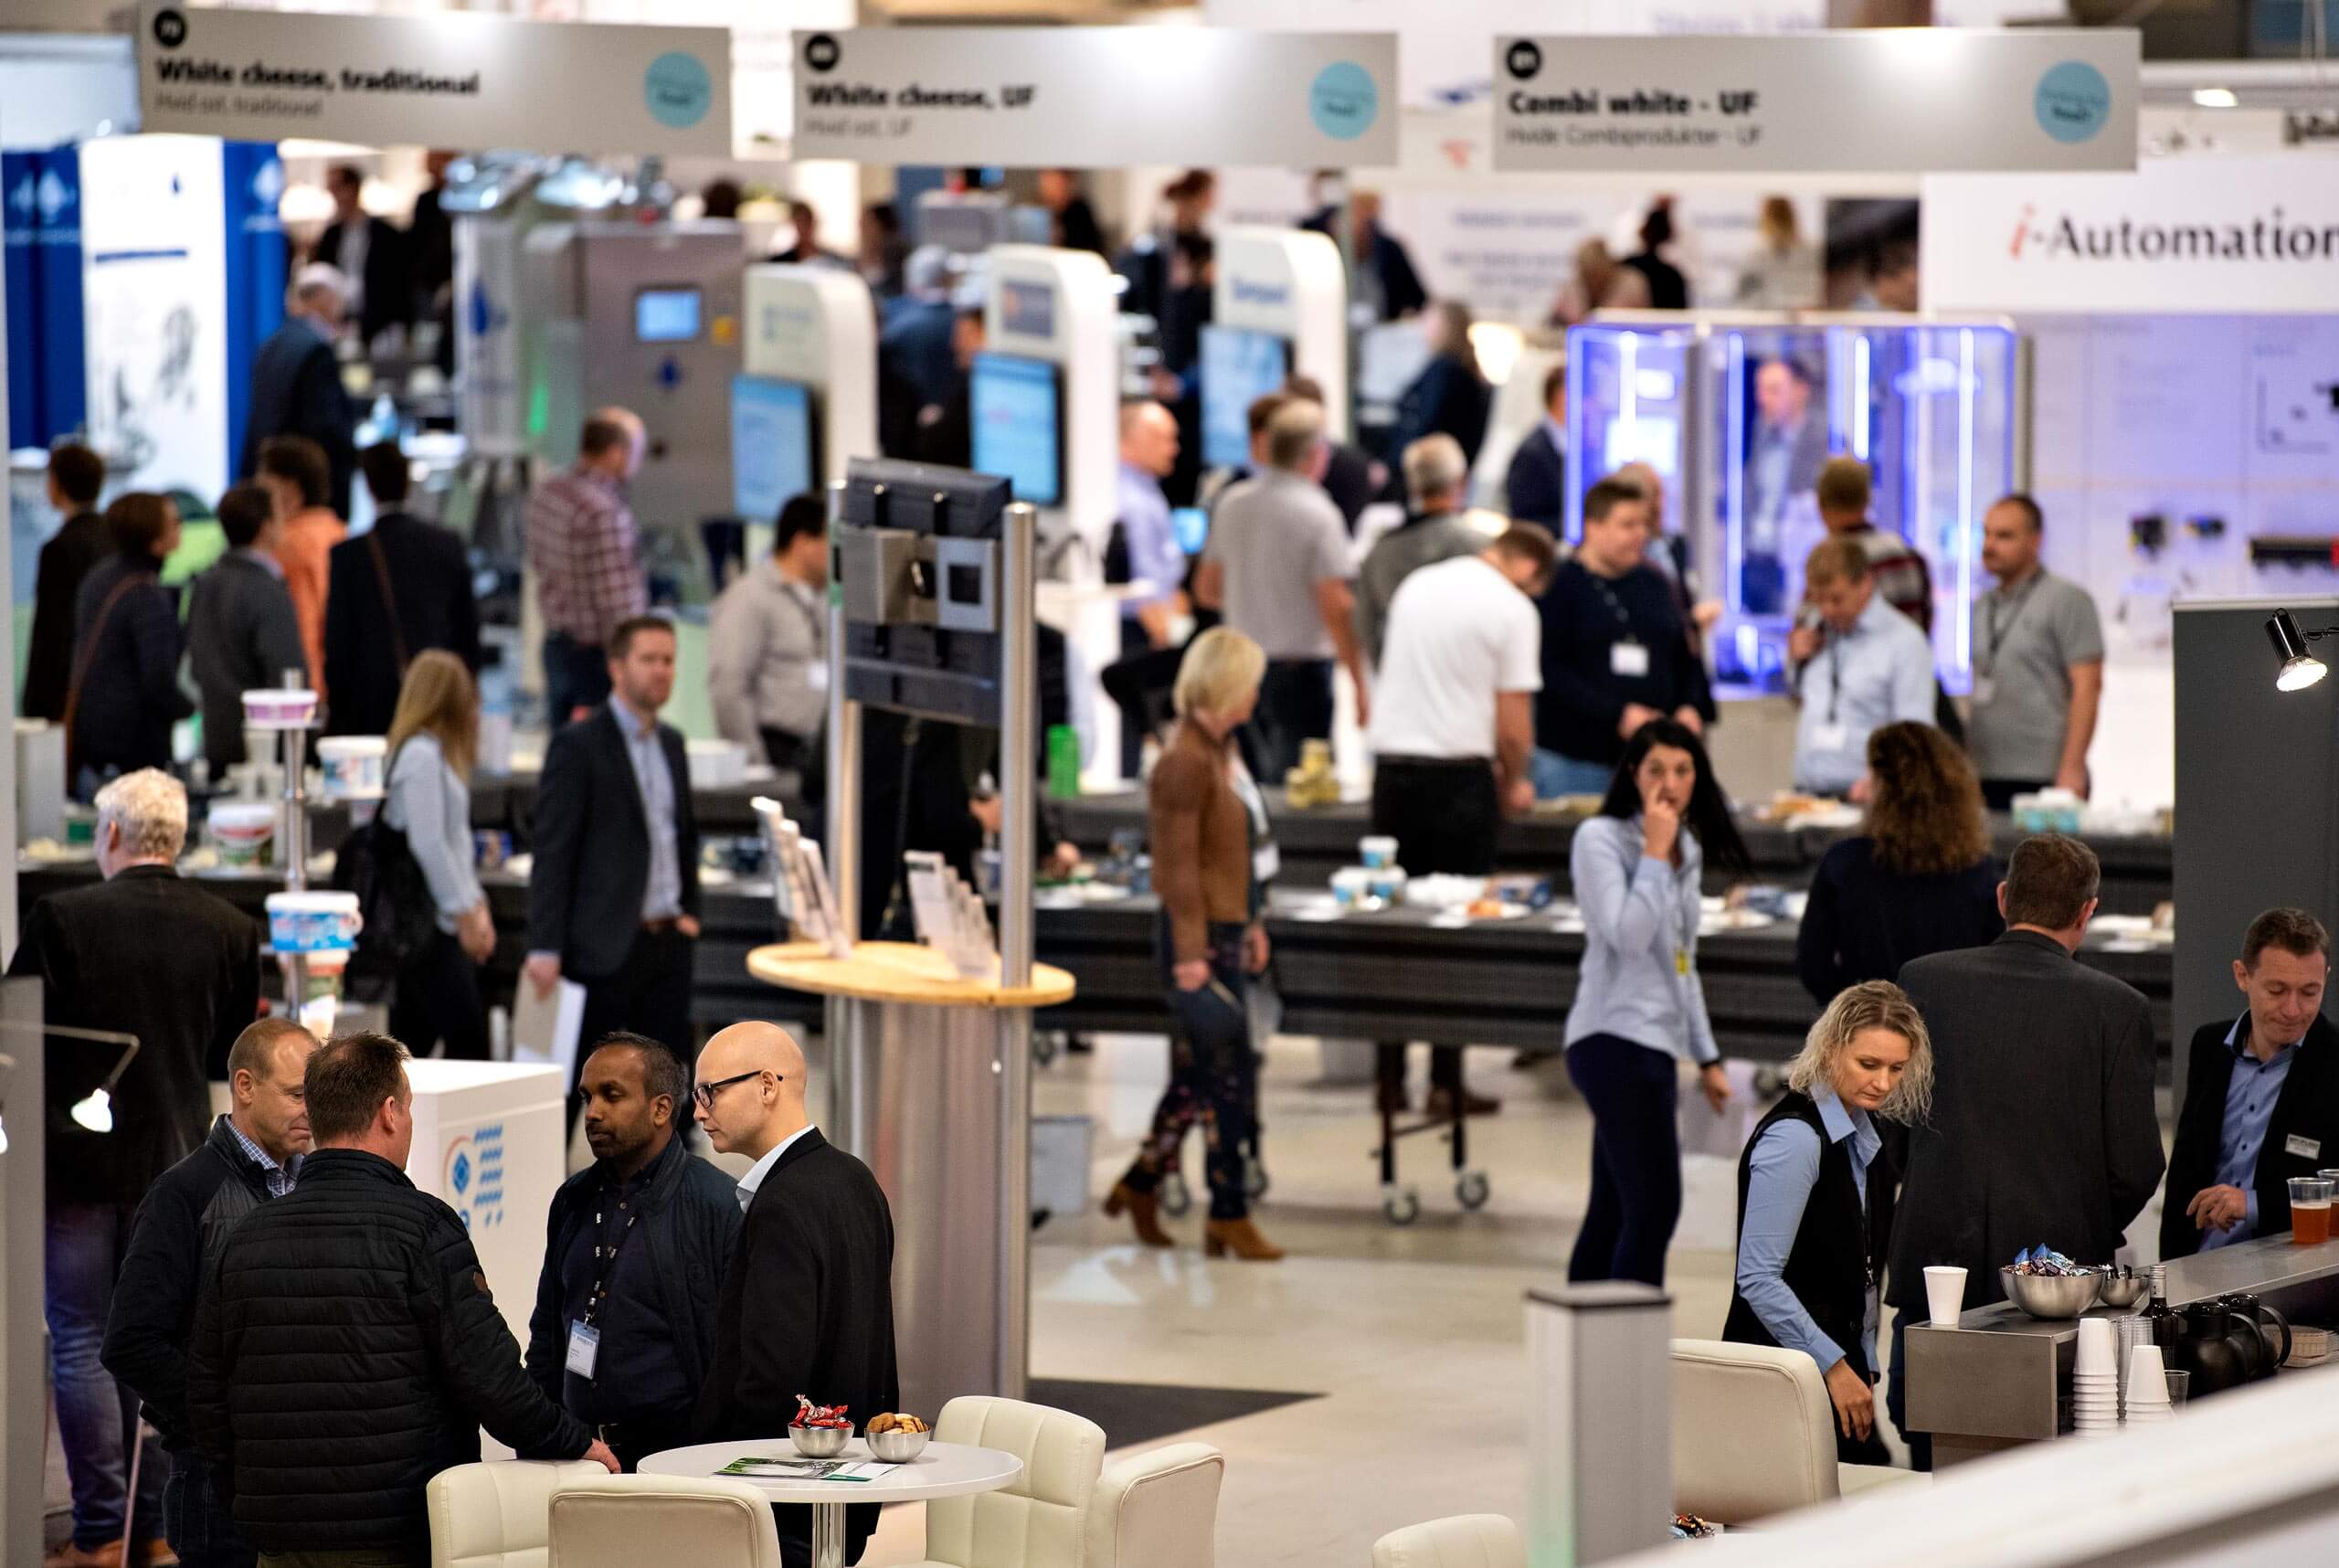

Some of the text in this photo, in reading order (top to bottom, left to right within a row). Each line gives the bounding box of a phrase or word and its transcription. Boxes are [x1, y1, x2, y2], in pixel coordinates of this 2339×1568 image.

[156, 58, 480, 94] White cheese, traditional
[807, 82, 1035, 110] White cheese, UF
[1509, 90, 1597, 115] Combi
[1606, 90, 1689, 115] white
[1720, 90, 1759, 115] UF
